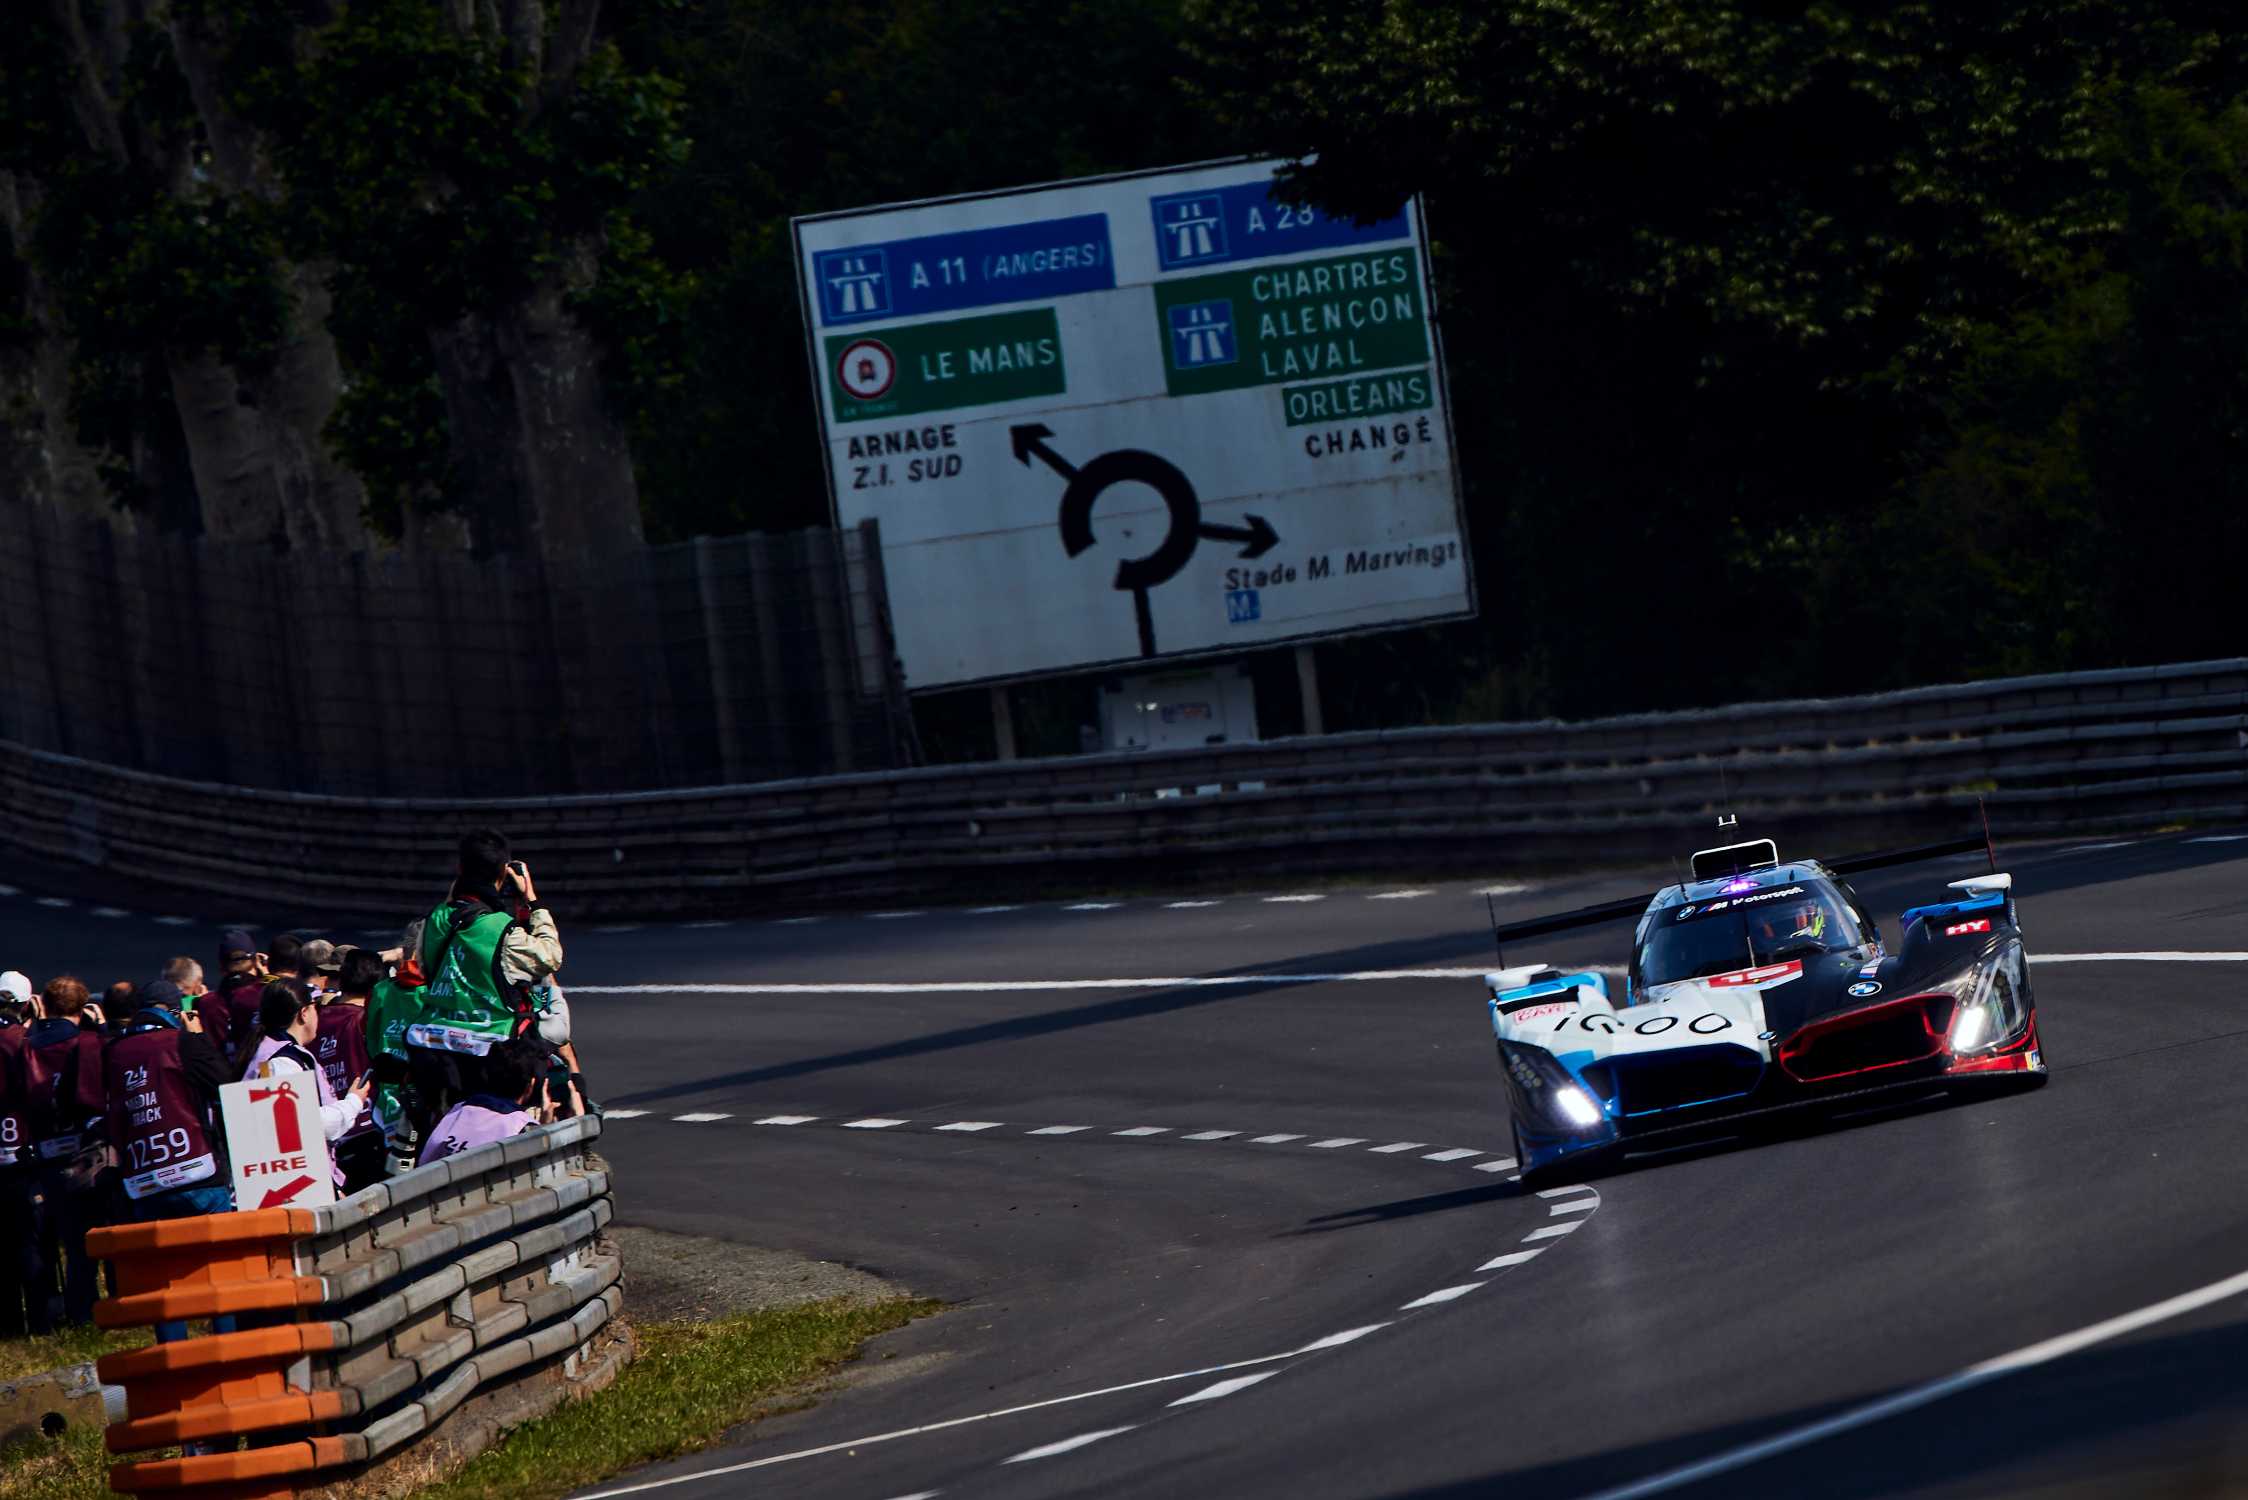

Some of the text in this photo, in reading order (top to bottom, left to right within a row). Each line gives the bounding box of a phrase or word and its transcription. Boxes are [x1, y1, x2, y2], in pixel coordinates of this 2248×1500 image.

[1248, 206, 1266, 233] A
[910, 241, 1106, 288] A 11 (ANGERS)
[1252, 256, 1408, 301] CHARTRES
[920, 338, 1056, 382] LE MANS
[1261, 339, 1364, 377] LAVAL
[1289, 376, 1427, 419] ORLÉANS
[848, 424, 957, 459] ARNAGE
[1305, 416, 1431, 457] CHANGÉ
[852, 454, 962, 490] Z.I. SUD
[1225, 541, 1457, 590] Stade M. Marvingt
[1732, 886, 1806, 907] Motorsport
[1946, 919, 1986, 937] HY
[126, 1127, 191, 1171] 1259
[243, 1156, 308, 1178] FIRE
